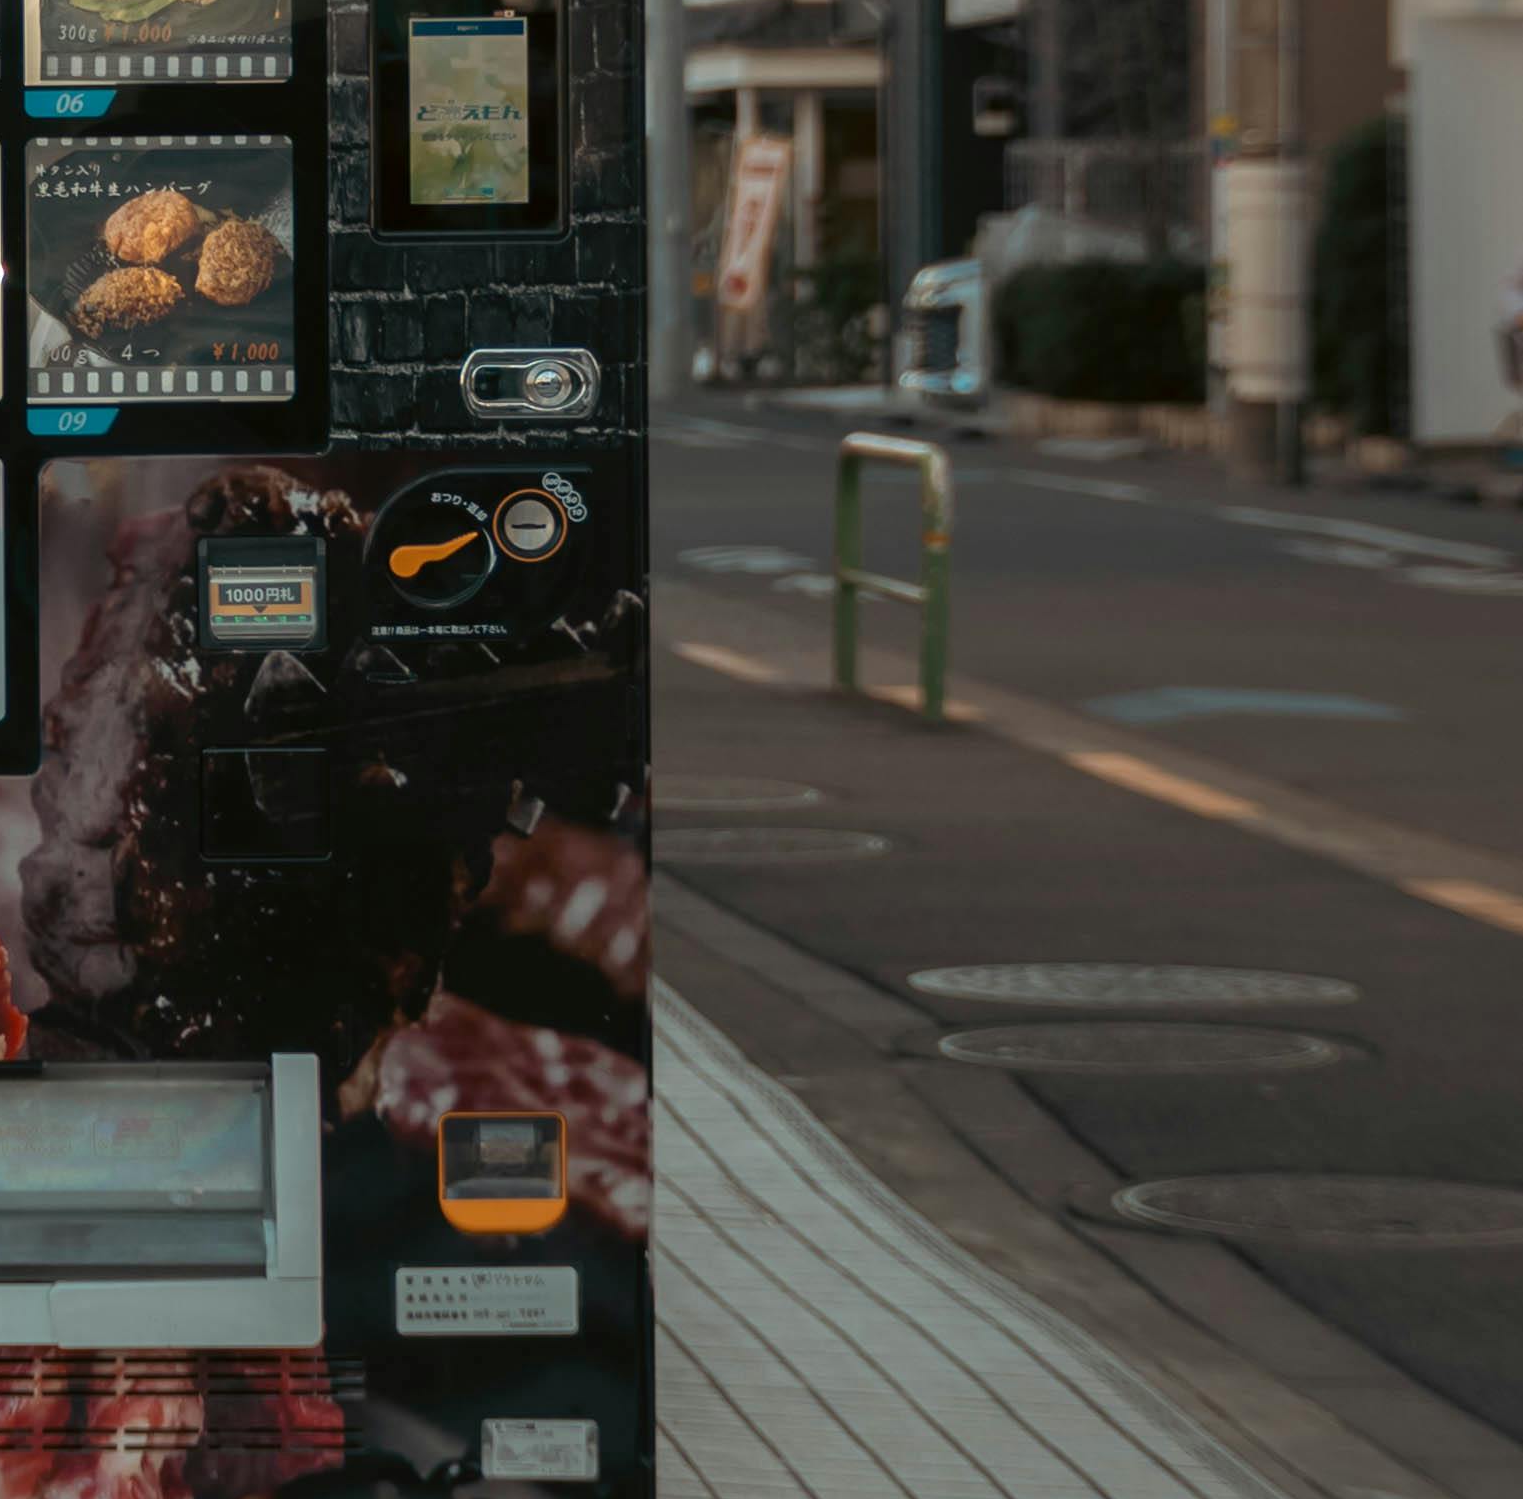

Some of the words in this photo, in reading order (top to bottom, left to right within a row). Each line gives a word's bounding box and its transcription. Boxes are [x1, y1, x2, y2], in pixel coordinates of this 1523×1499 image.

[57, 24, 97, 43] 300g
[55, 93, 85, 113] 06
[58, 411, 87, 432] 09
[430, 491, 489, 522] おつり・返却
[225, 587, 296, 604] 1000円札
